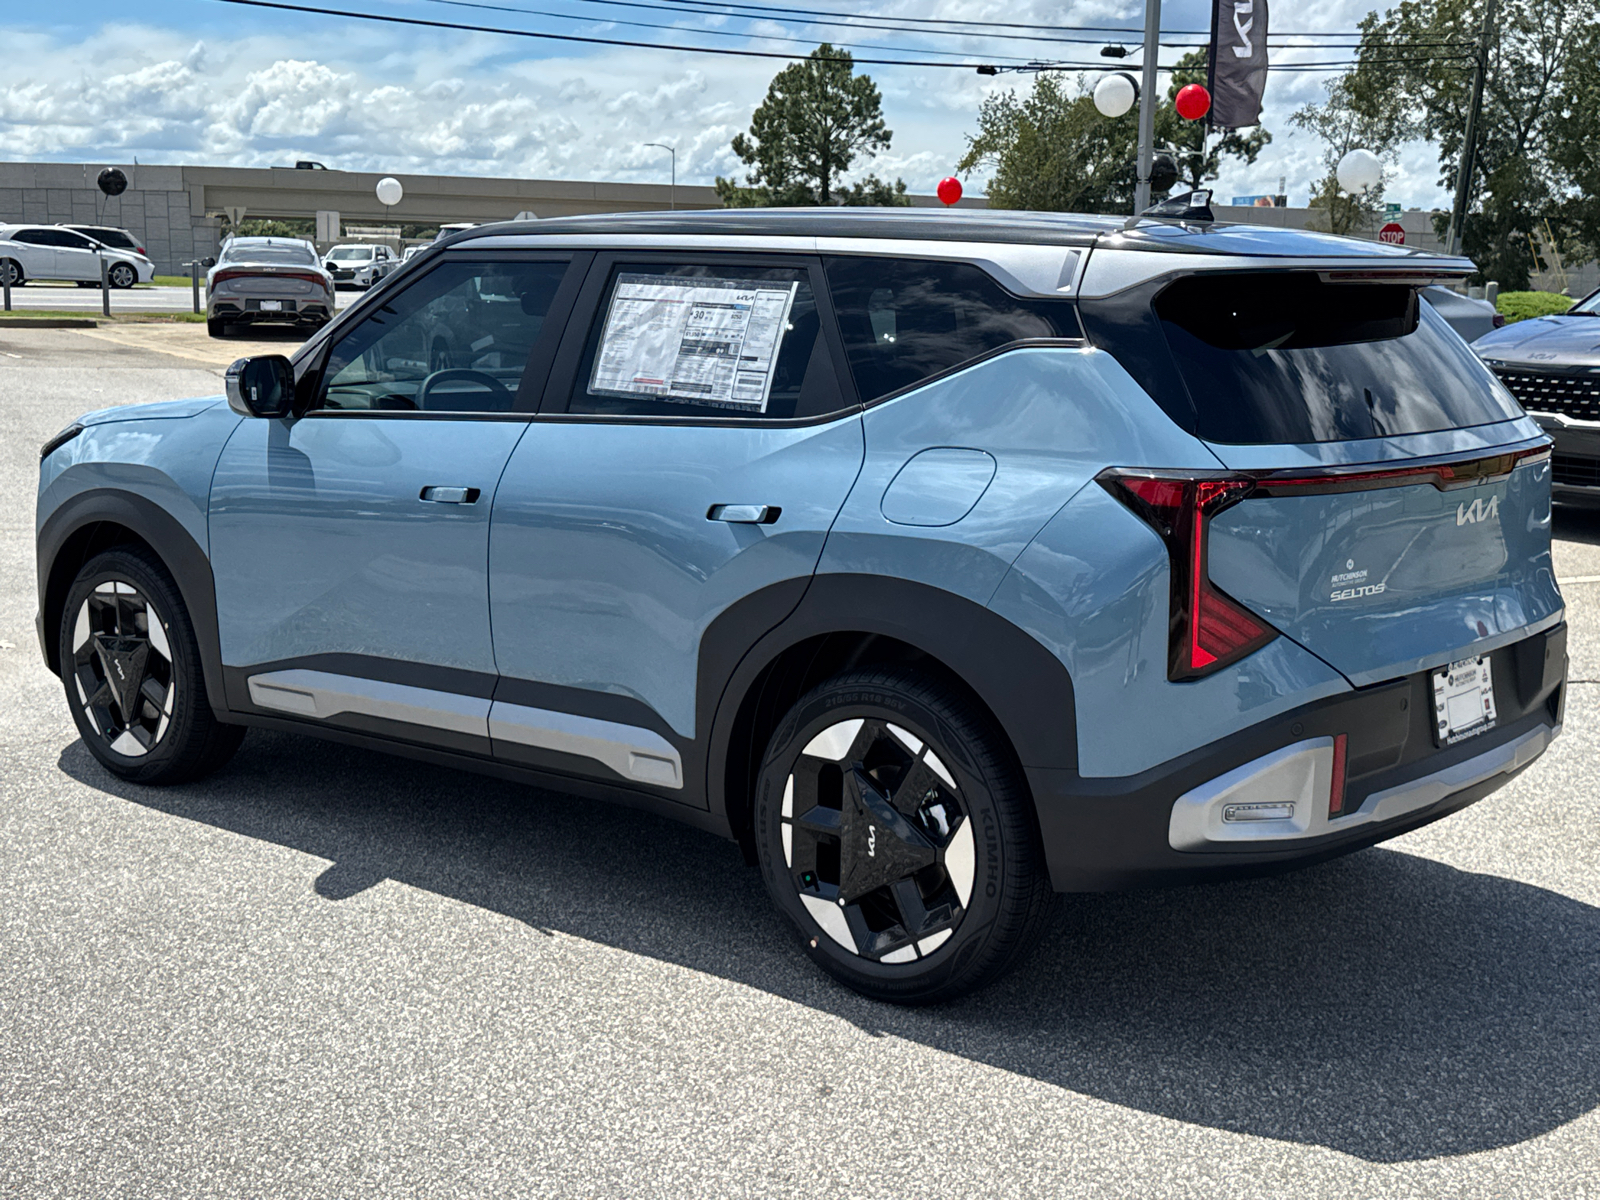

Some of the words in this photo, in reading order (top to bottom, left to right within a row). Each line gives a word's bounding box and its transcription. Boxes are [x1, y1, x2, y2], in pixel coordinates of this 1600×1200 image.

[1232, 0, 1253, 58] KI
[1380, 231, 1405, 243] STOP
[693, 310, 705, 320] 30
[1527, 352, 1558, 361] KIA
[1457, 495, 1497, 526] KIA
[1331, 569, 1368, 583] HUTCHINSON
[1330, 583, 1385, 602] SELTOS
[114, 658, 126, 680] KIA
[168, 689, 186, 747] KUMHO
[867, 824, 876, 858] KIA
[980, 807, 999, 898] KUMHO
